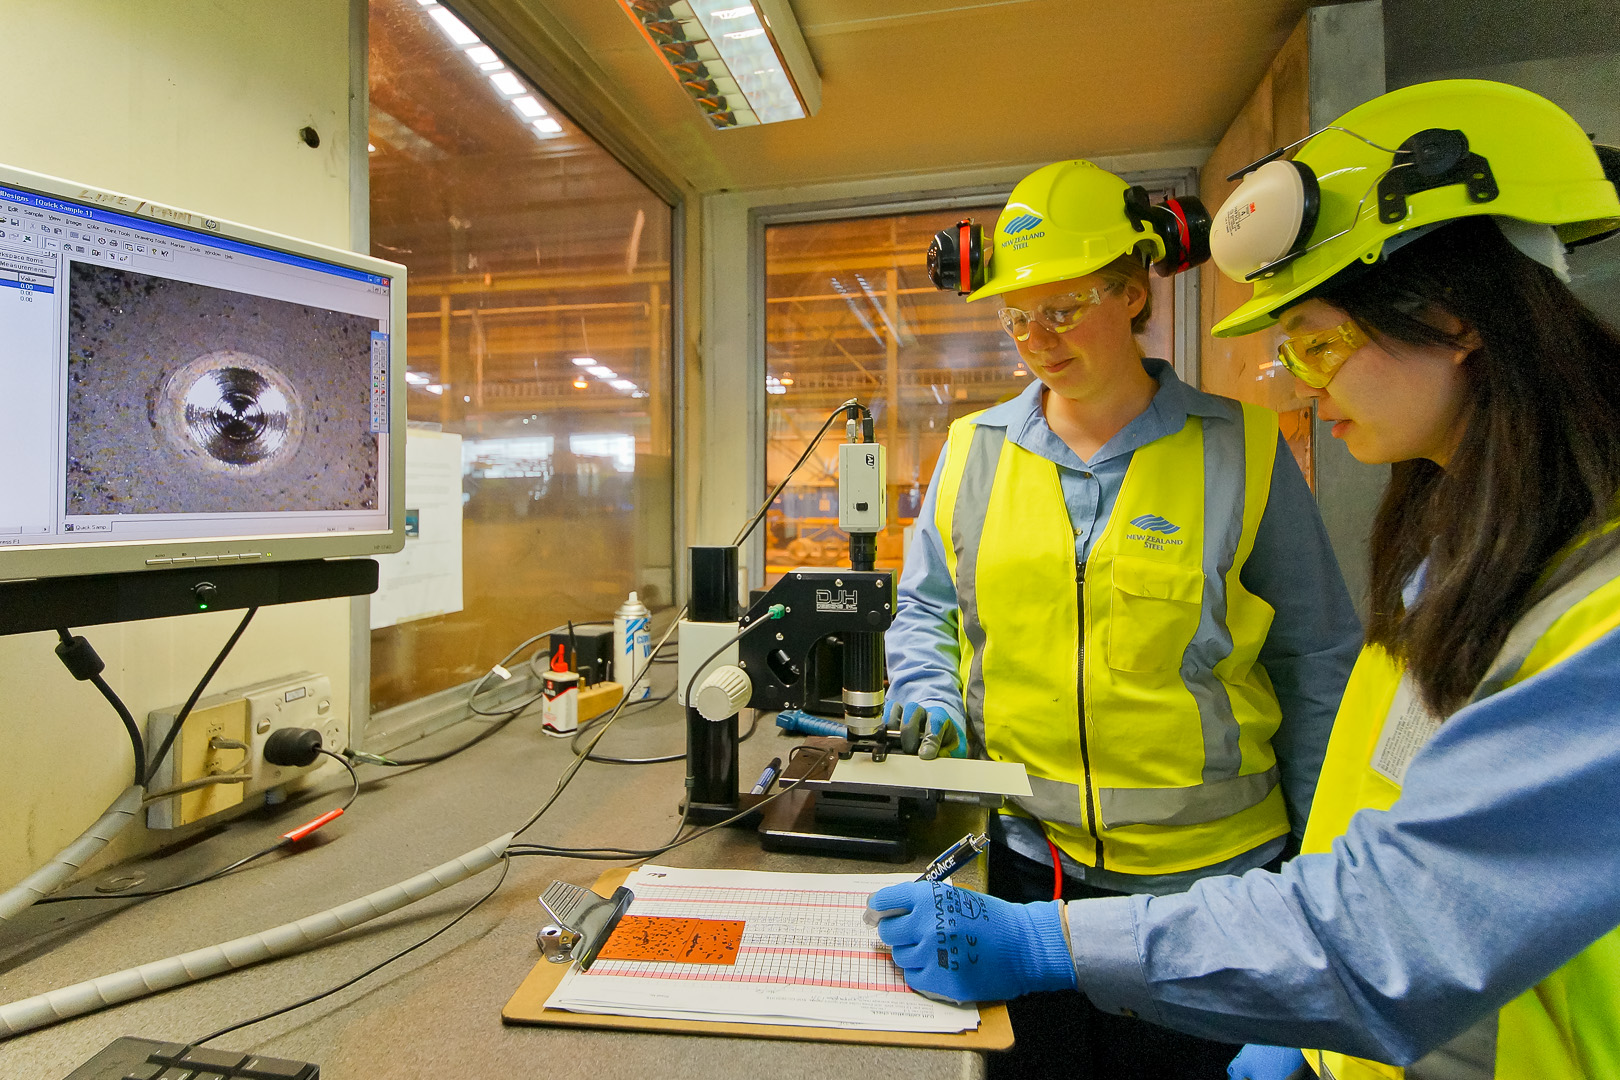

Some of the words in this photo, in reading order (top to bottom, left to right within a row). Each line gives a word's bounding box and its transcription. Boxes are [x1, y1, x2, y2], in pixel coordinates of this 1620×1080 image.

[60, 203, 84, 214] Sample
[7, 205, 19, 213] Edit
[24, 209, 44, 218] Sample
[48, 214, 61, 222] View
[65, 218, 82, 227] Image
[134, 233, 154, 243] Drawing
[170, 241, 186, 249] Marker
[1002, 239, 1014, 248] NEW
[1015, 232, 1045, 243] ZEALAND
[1013, 242, 1028, 250] STEEL
[1144, 541, 1165, 551] STEEL
[1147, 535, 1183, 545] ZEALAND
[816, 589, 857, 604] DJH
[925, 854, 957, 882] BOUNCE
